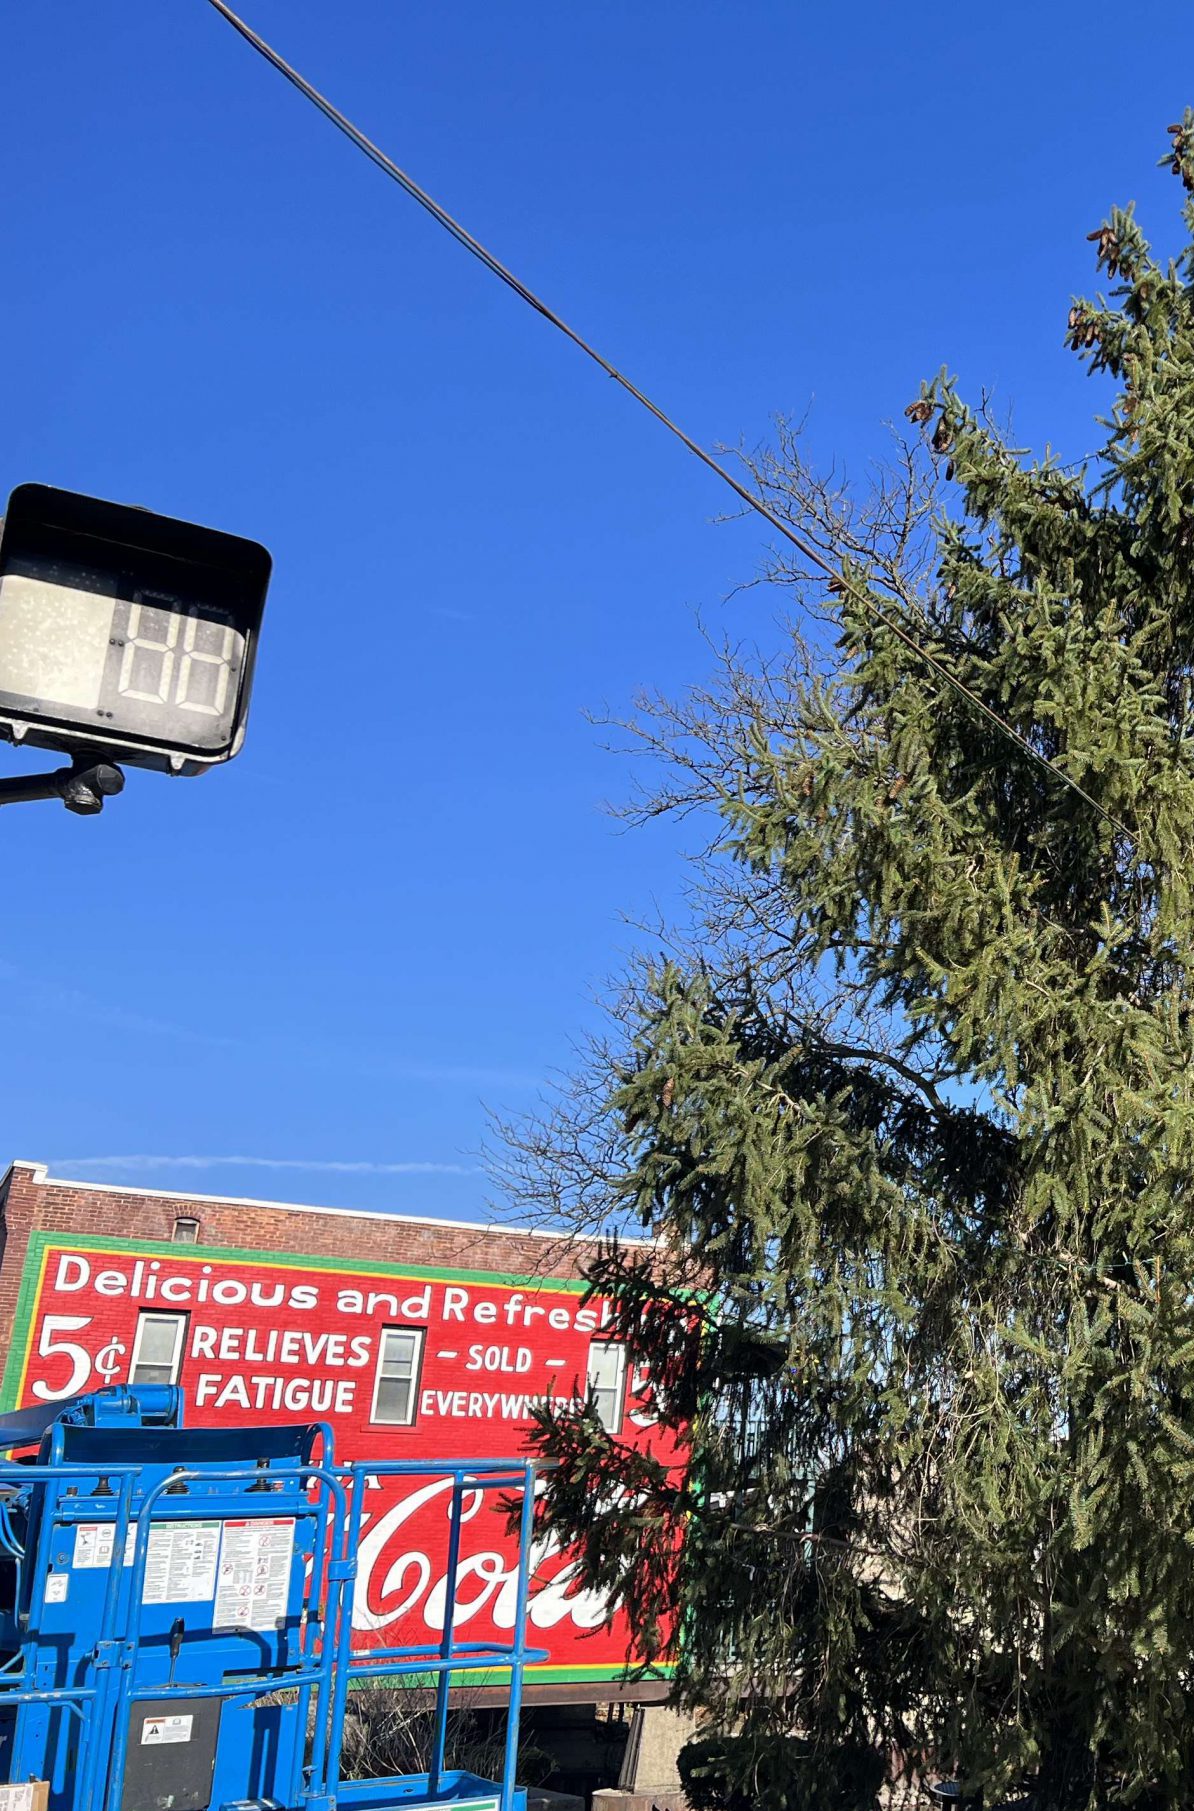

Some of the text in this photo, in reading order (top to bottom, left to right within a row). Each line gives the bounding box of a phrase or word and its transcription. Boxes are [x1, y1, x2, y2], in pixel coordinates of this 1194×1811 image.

[54, 1254, 319, 1309] Delicious
[337, 1285, 432, 1319] and
[191, 1325, 372, 1367] RELIEVES
[465, 1344, 532, 1373] SOLD
[195, 1373, 356, 1412] FATIGUE
